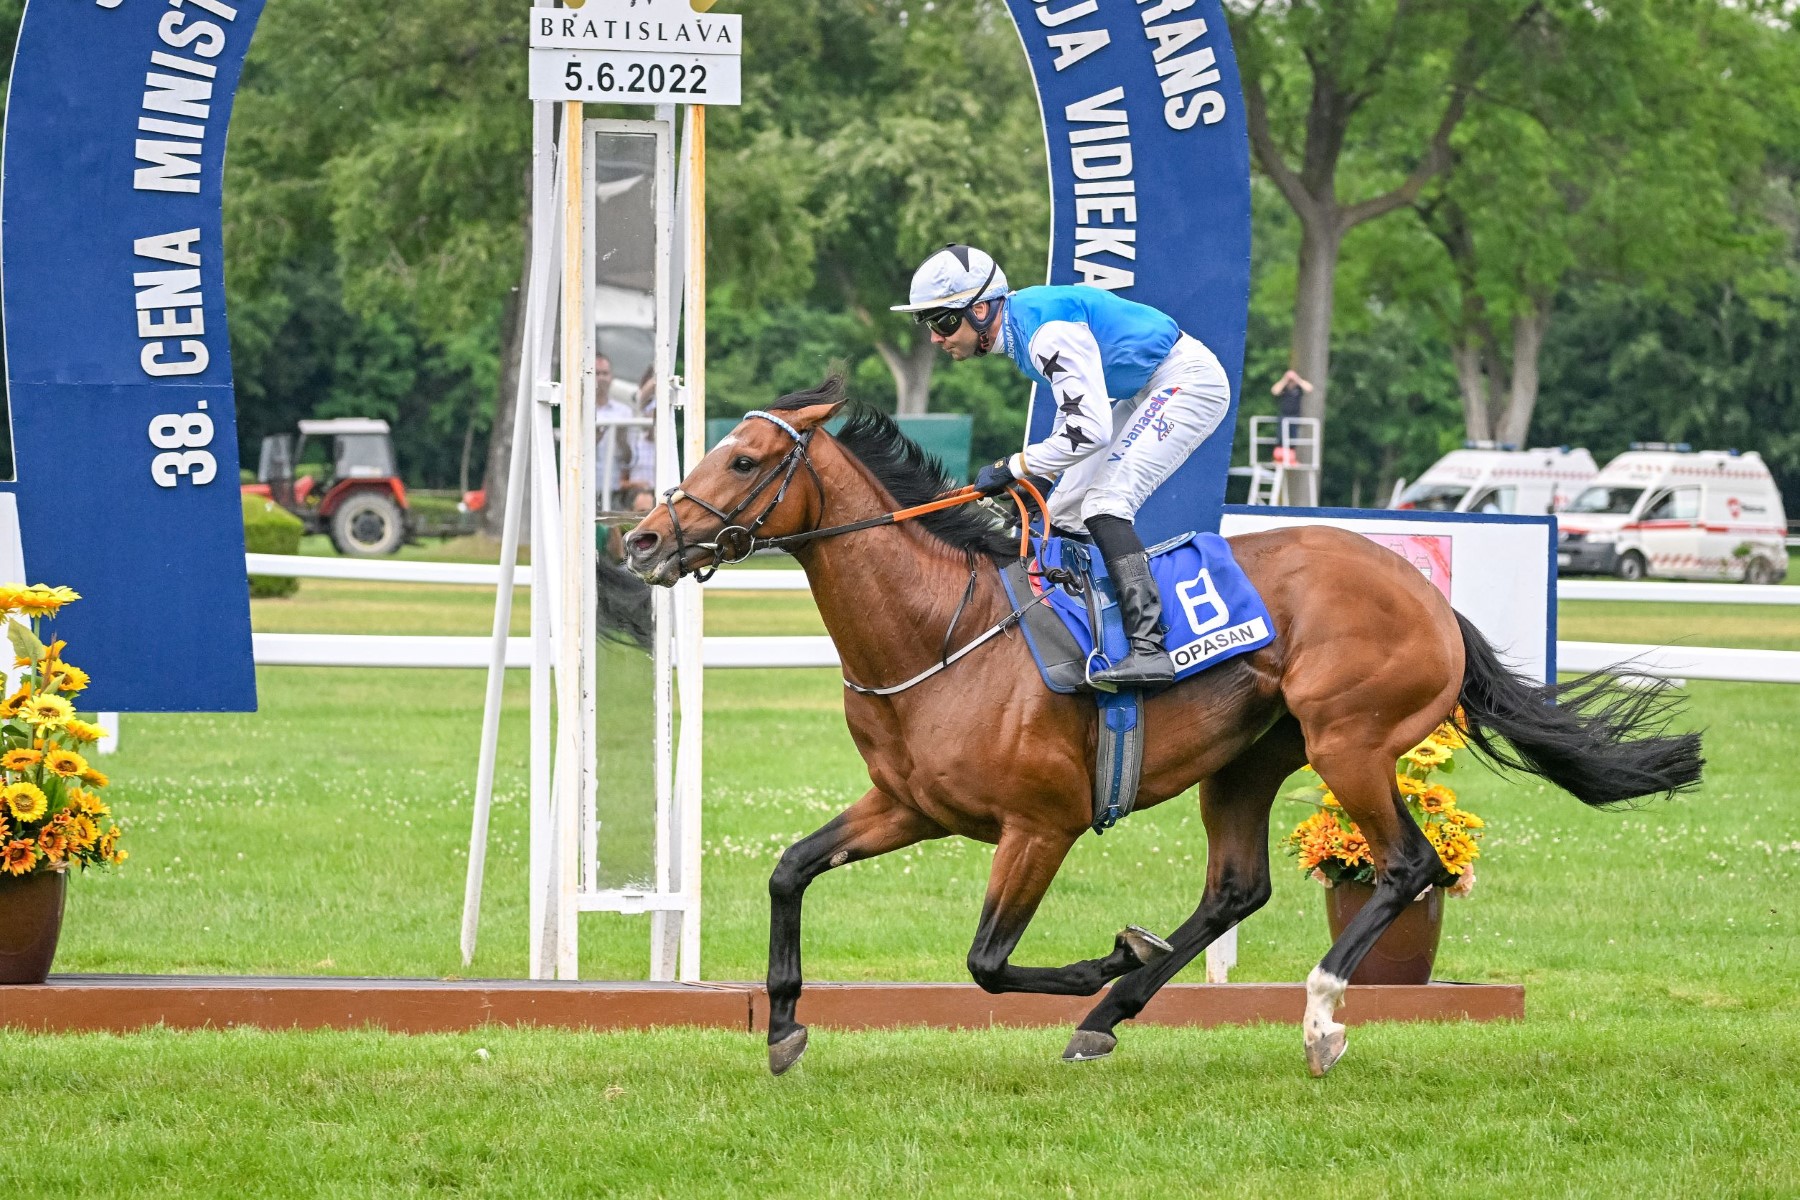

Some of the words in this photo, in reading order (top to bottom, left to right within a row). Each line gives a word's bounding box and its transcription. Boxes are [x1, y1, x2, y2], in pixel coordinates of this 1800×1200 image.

[541, 18, 732, 43] BRATISLAVA
[1033, 0, 1111, 72] JA
[565, 62, 707, 94] 5.6.2022
[1065, 86, 1137, 290] VIDIEKA
[134, 228, 209, 376] CENA
[149, 400, 217, 488] 38.
[1175, 568, 1229, 635] 8
[1174, 626, 1255, 666] OPASAN
